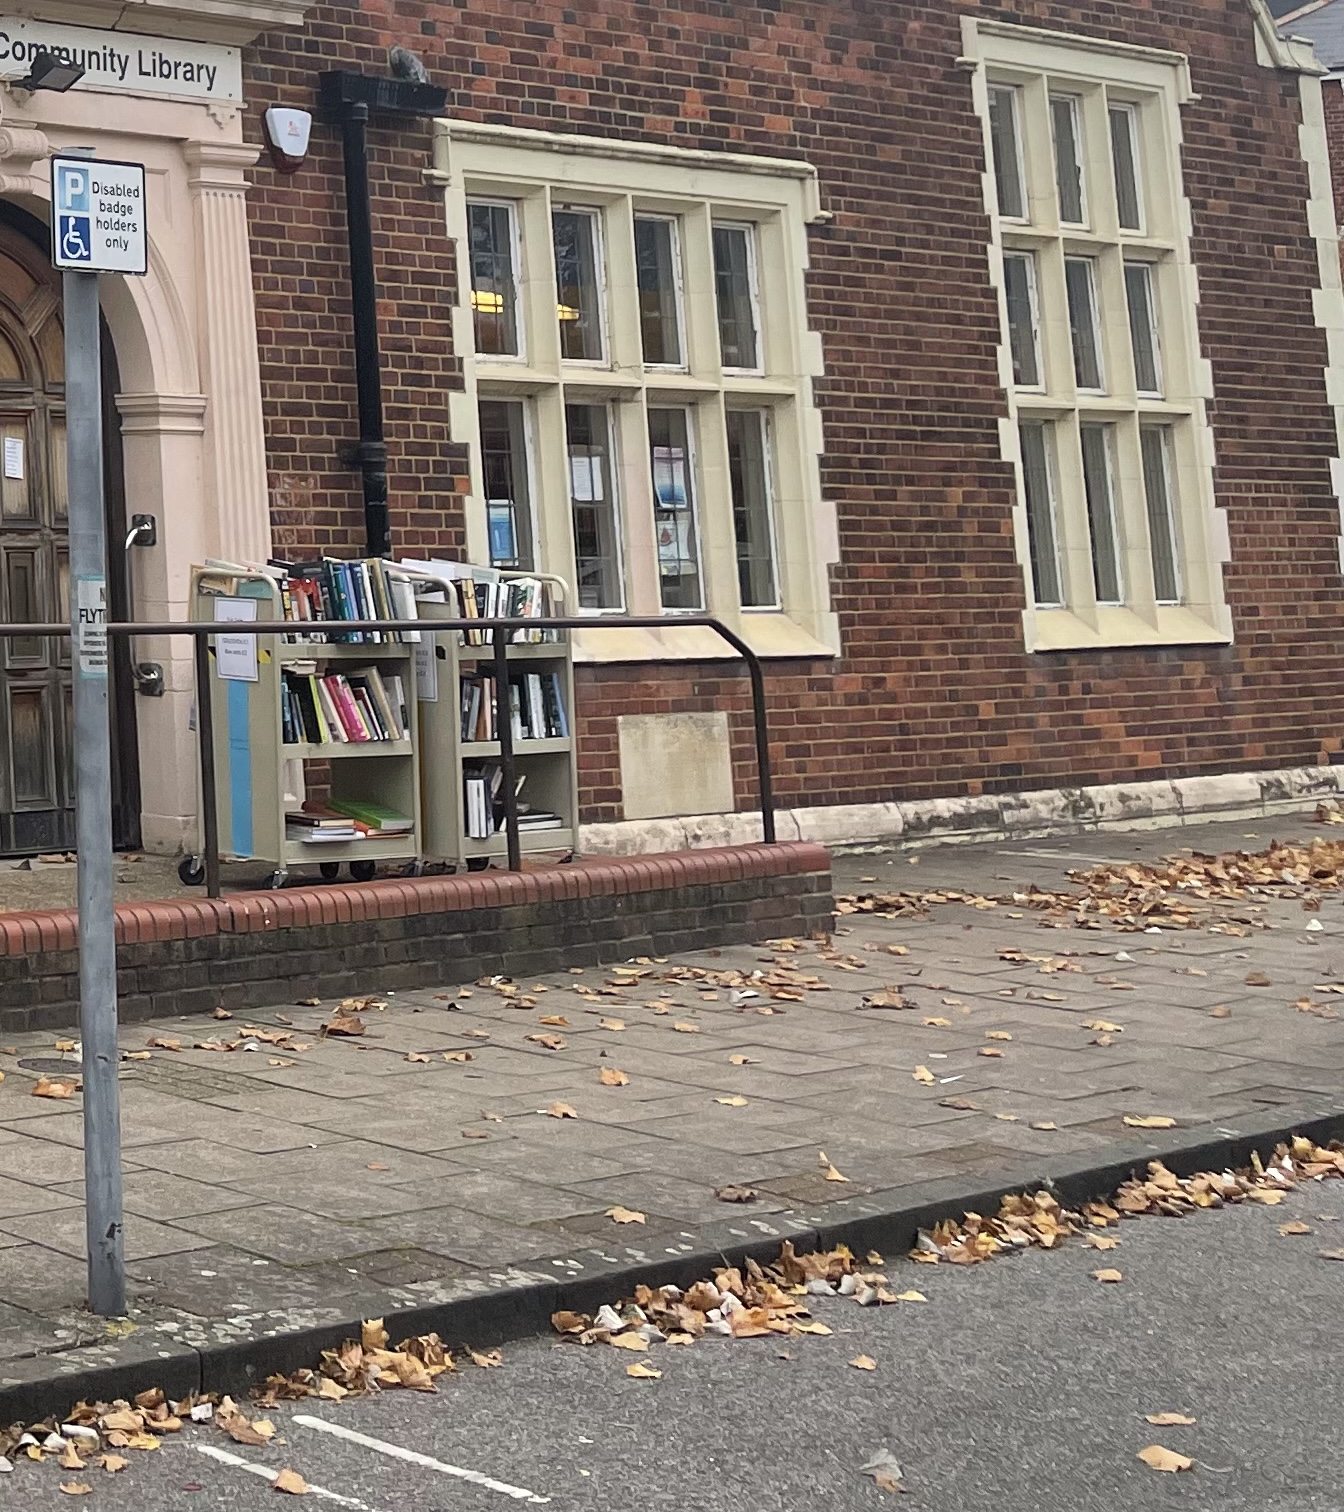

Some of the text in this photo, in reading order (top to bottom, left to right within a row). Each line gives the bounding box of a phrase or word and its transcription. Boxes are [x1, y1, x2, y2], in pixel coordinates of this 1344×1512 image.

[137, 49, 217, 91] Library
[64, 171, 84, 208] P
[92, 181, 140, 198] Disabled
[99, 200, 133, 216] badge
[96, 216, 138, 233] holders
[105, 236, 129, 252] only
